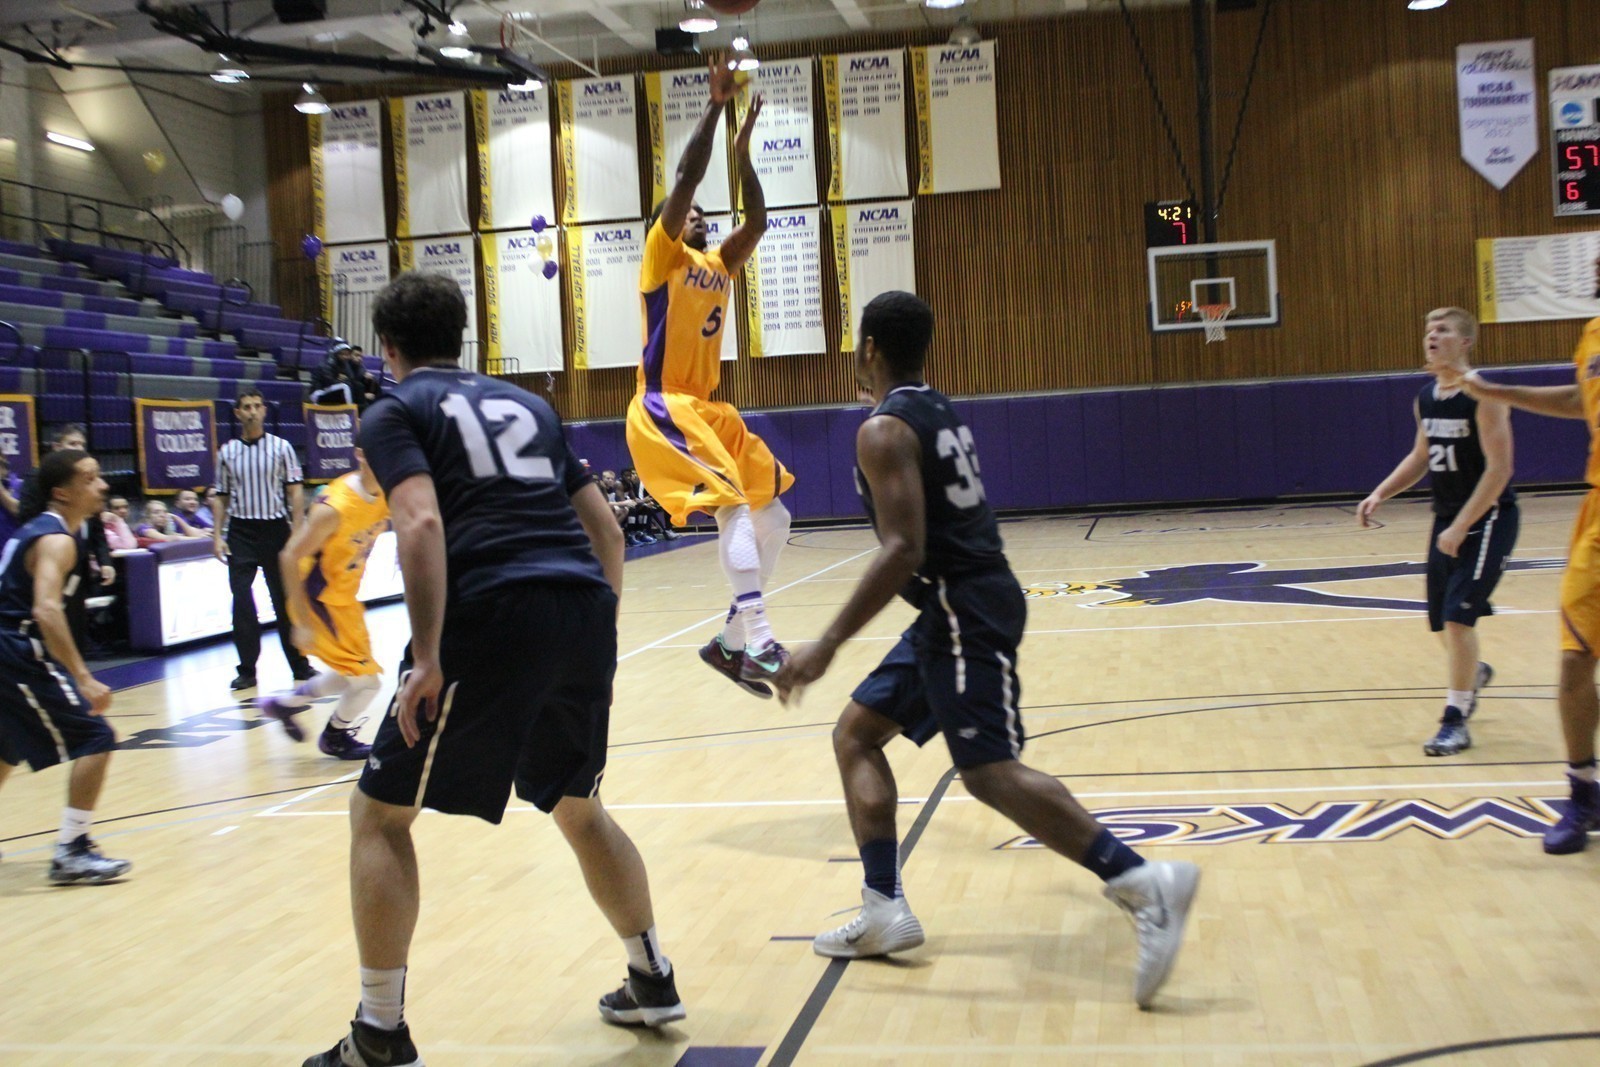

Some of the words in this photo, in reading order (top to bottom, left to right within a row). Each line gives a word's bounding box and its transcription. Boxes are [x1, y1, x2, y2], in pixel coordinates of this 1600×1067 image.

[850, 56, 890, 71] NCAA
[940, 49, 980, 63] NCAA
[757, 64, 802, 79] NIWFA
[935, 65, 989, 75] TOURNAMENT
[673, 73, 710, 88] NCAA
[844, 73, 897, 83] TOURNAMENT
[584, 80, 622, 95] NCAA
[667, 89, 708, 99] TOURNAME
[498, 88, 535, 103] NCAA
[578, 97, 630, 108] TOURNAMENT
[1463, 92, 1531, 110] TOURNAMENT
[415, 97, 453, 113] NCAA
[492, 104, 544, 116] TOURNAMENT
[561, 86, 572, 131] COUNTRY
[331, 106, 369, 120] NCAA
[474, 95, 486, 145] COUNTRY
[651, 101, 661, 148] FENCING
[763, 138, 802, 152] NCAA
[565, 138, 574, 170] CROSS
[757, 154, 810, 164] TOURNAMENT
[1565, 145, 1599, 170] 57
[478, 151, 488, 187] CROSS
[565, 176, 574, 219] WOMEN'S
[1566, 181, 1580, 201] 6
[480, 193, 490, 225] MEN'S
[858, 207, 899, 221] NCAA
[1158, 206, 1192, 221] 4:21
[767, 215, 806, 229] NCAA
[853, 224, 908, 234] TOURNAMENT
[594, 229, 632, 243] NCAA
[762, 231, 815, 242] TOURNAMENT
[1172, 222, 1187, 245] 7
[424, 242, 461, 256] NCAA
[507, 237, 536, 250] NCA
[588, 244, 641, 255] TOURNAMENT
[340, 250, 377, 263] NCAA
[836, 224, 846, 287] VOLLEYBALL
[572, 245, 583, 300] SOFTBALL
[486, 265, 497, 306] SOCCER
[684, 266, 731, 299] HUNT
[489, 313, 498, 345] MEN'S
[701, 305, 723, 338] 5
[574, 306, 584, 353] WOMEN'S
[152, 410, 204, 431] HUNTER
[155, 432, 208, 453] COLLEGE
[440, 393, 555, 479] 12
[1428, 443, 1459, 472] 21
[992, 796, 1598, 852] WKS
